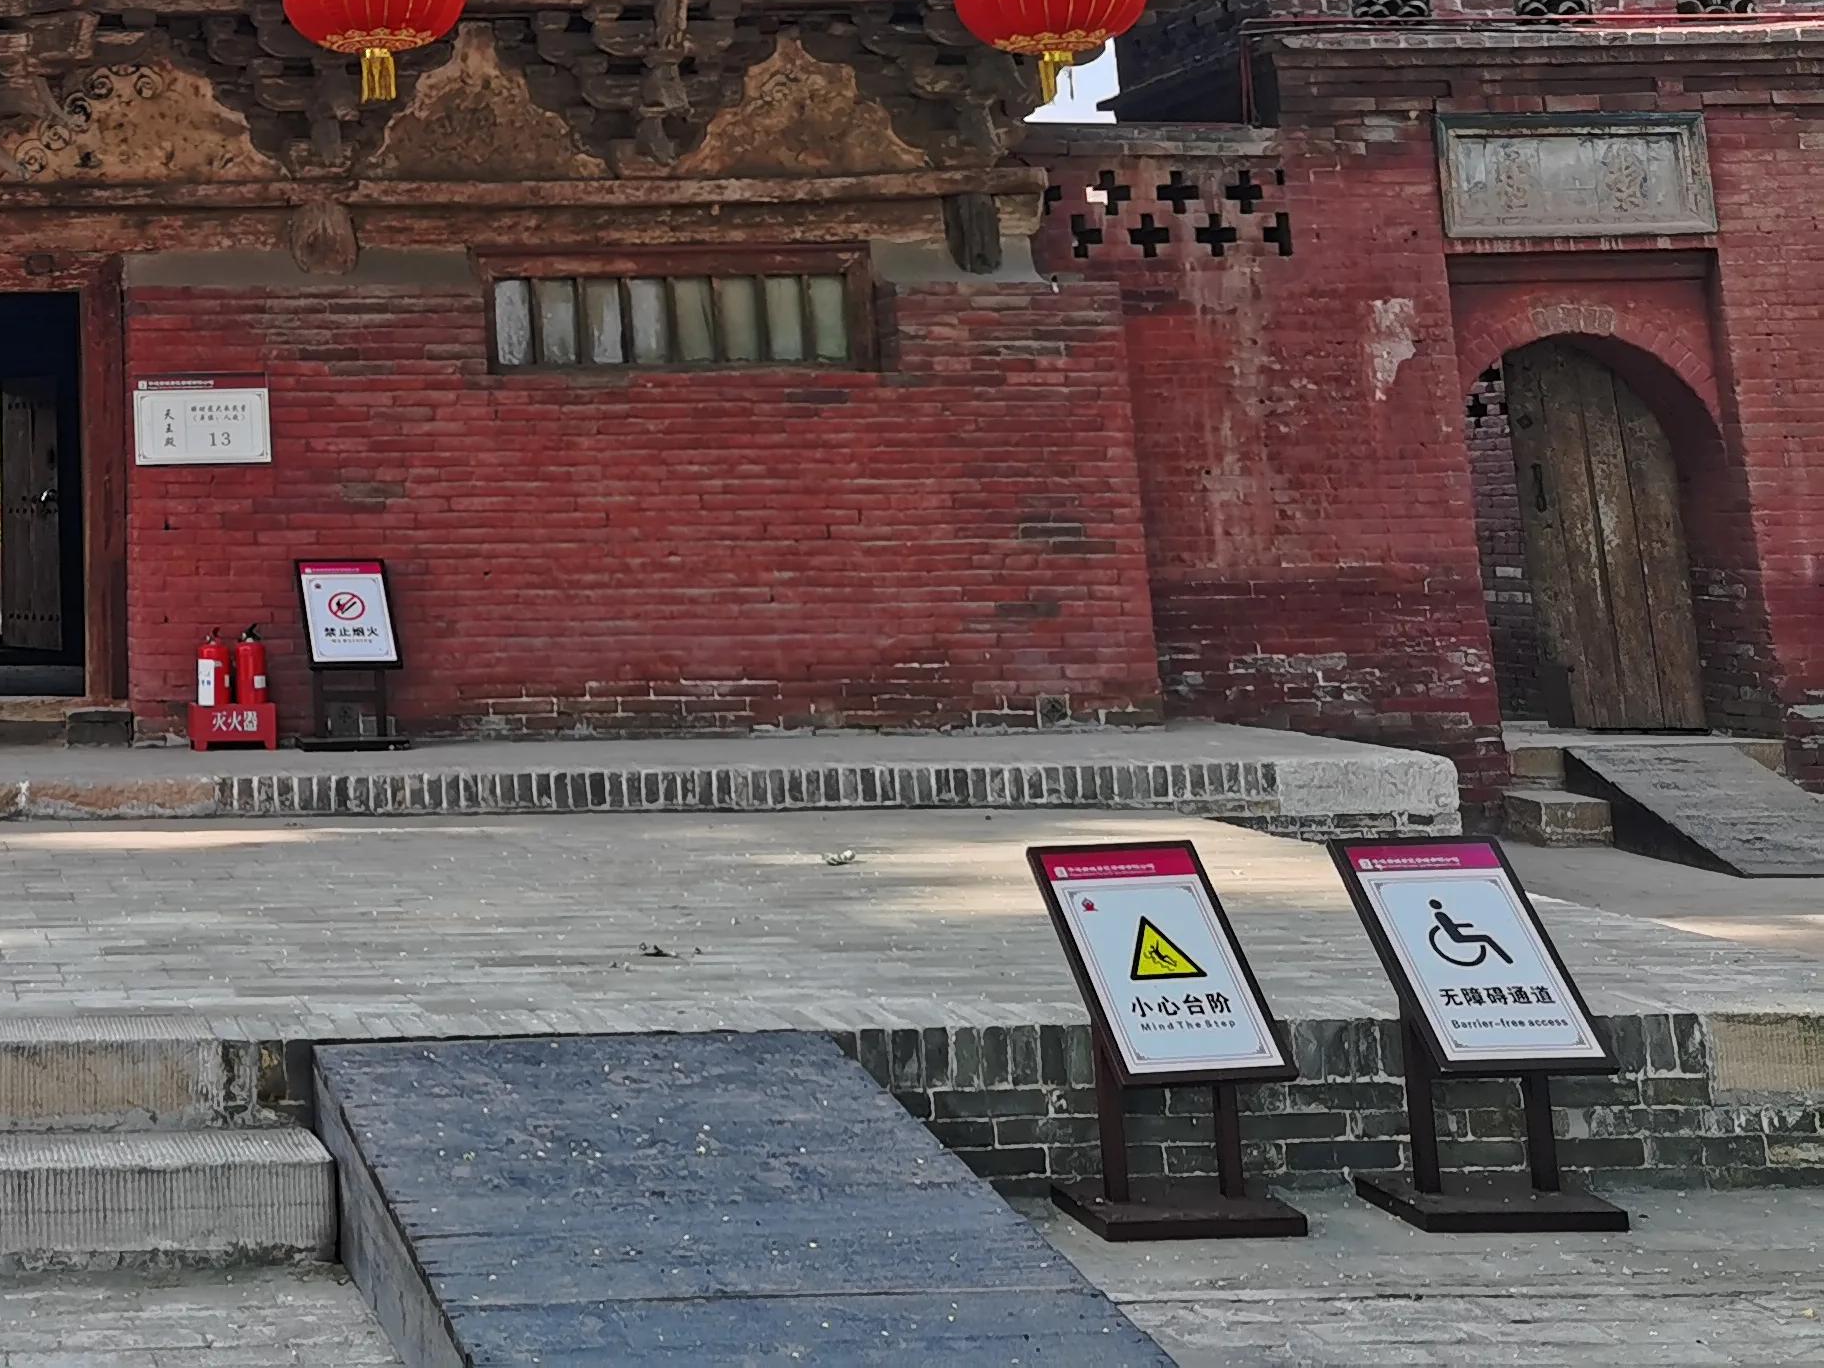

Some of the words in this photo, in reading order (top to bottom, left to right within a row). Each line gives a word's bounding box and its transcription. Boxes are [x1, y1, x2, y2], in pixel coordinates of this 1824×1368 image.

[209, 431, 232, 448] 13
[324, 626, 379, 637] 禁止烟火
[212, 710, 258, 732] 灭火器
[1438, 985, 1556, 1007] 无障碍通道
[1131, 992, 1233, 1018] 小心台阶
[1140, 1021, 1175, 1032] Mind
[1176, 1020, 1202, 1031] The
[1204, 1019, 1236, 1030] Step
[1451, 1018, 1526, 1030] Barrier-free
[1527, 1018, 1569, 1028] access
